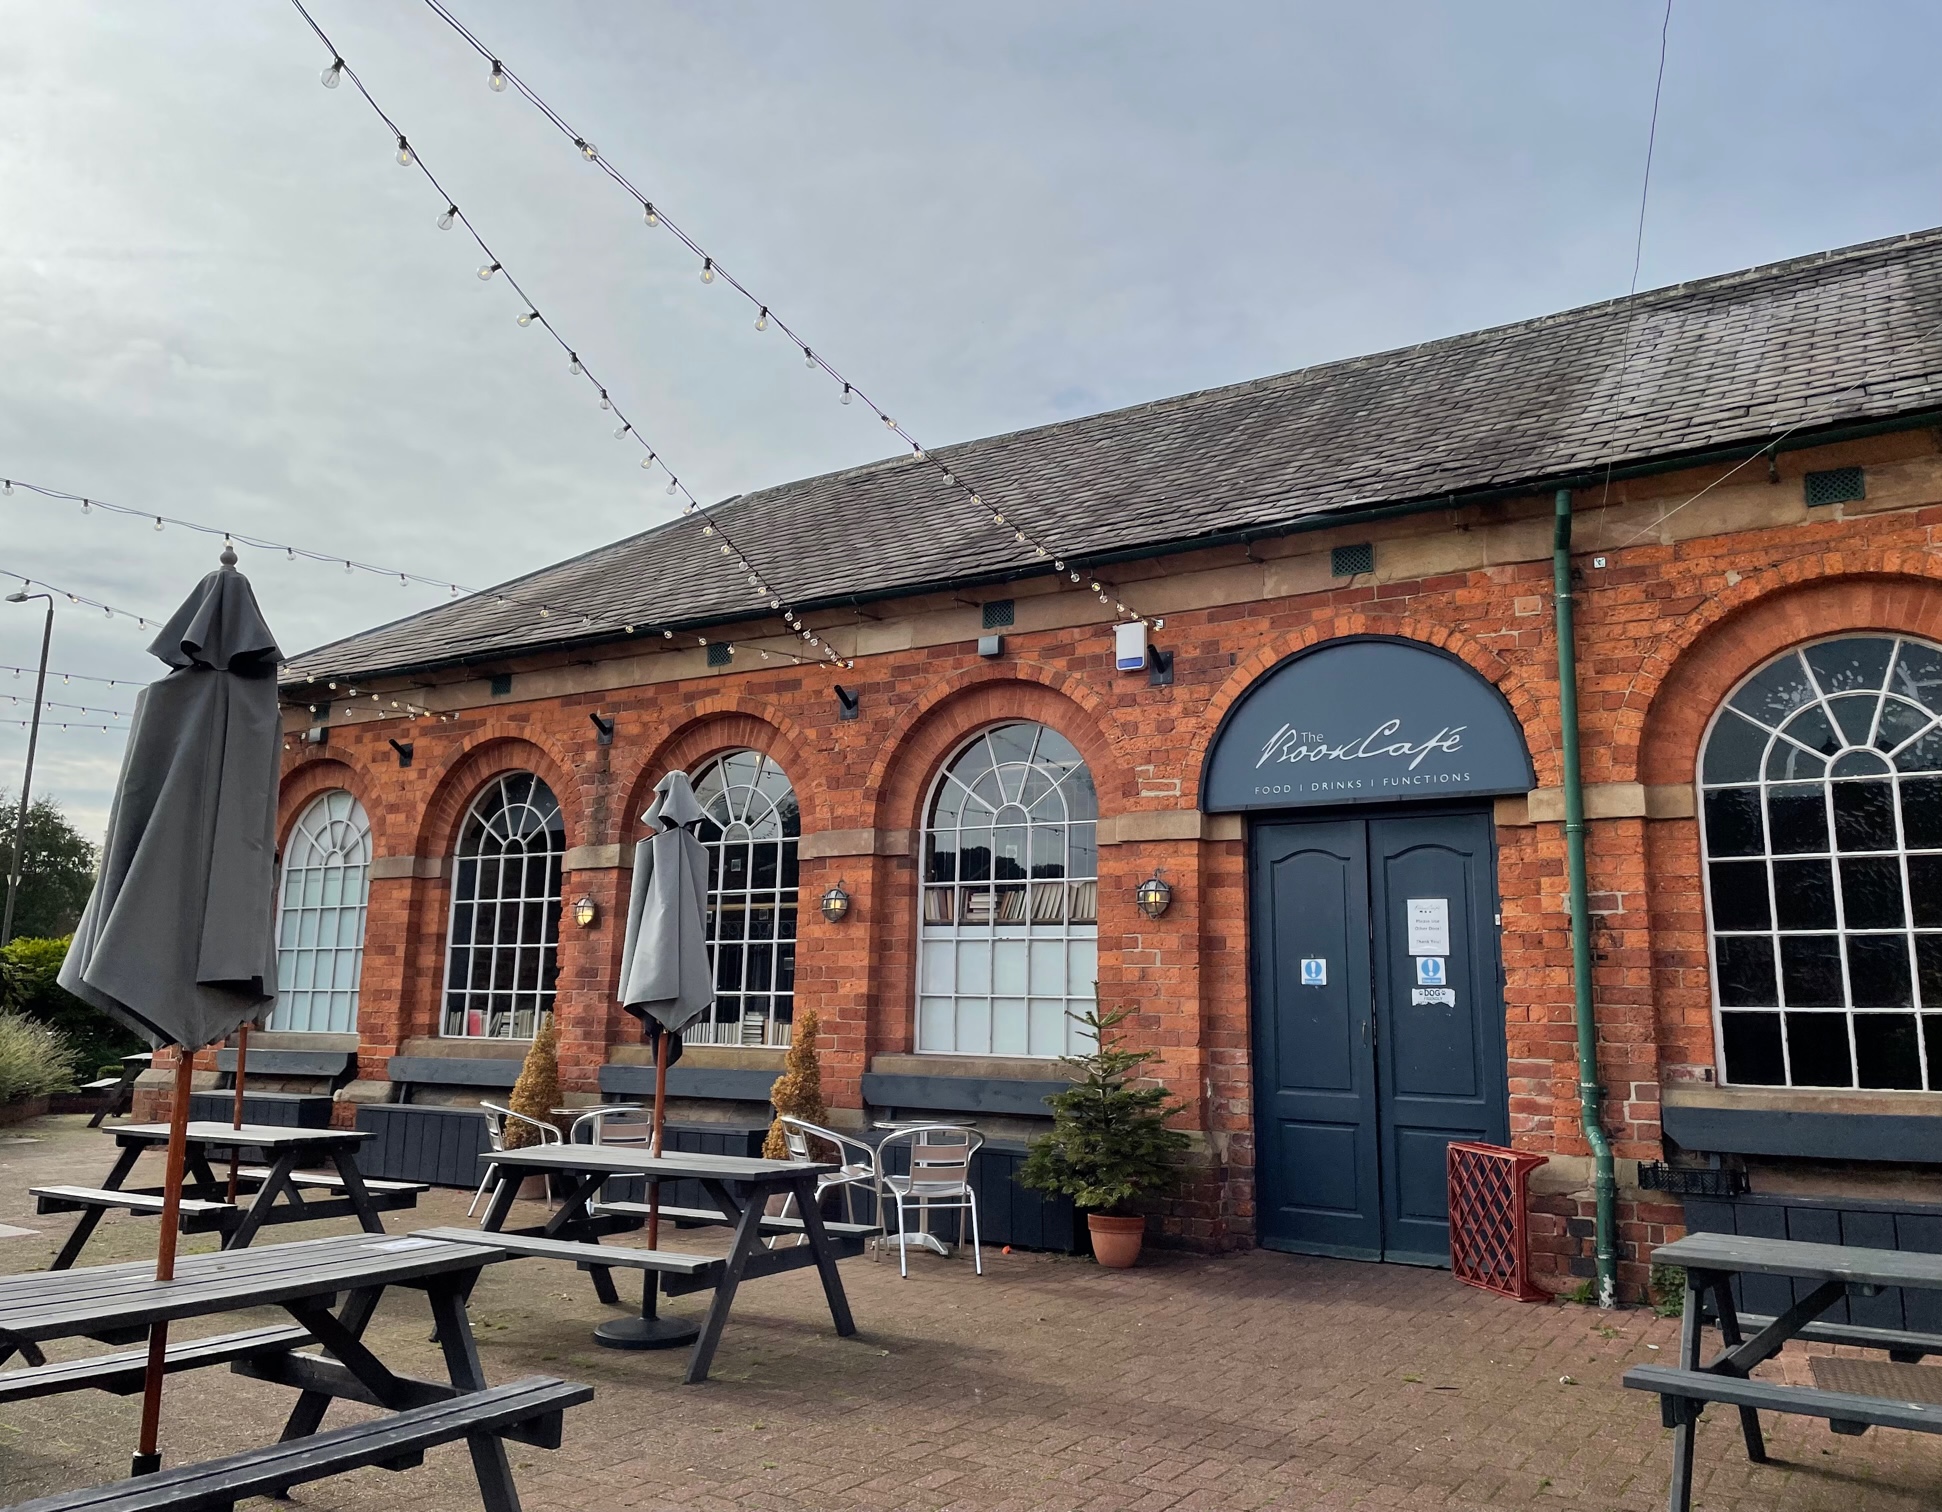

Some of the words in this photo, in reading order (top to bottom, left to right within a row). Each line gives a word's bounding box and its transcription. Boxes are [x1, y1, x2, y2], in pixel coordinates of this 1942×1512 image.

[1255, 722, 1361, 769] Book
[1358, 718, 1468, 771] Café
[1300, 731, 1324, 743] The
[1254, 784, 1291, 795] FOOD
[1311, 779, 1362, 792] DRINKS
[1383, 772, 1470, 787] FUNCTIONS
[1424, 989, 1441, 997] DOG
